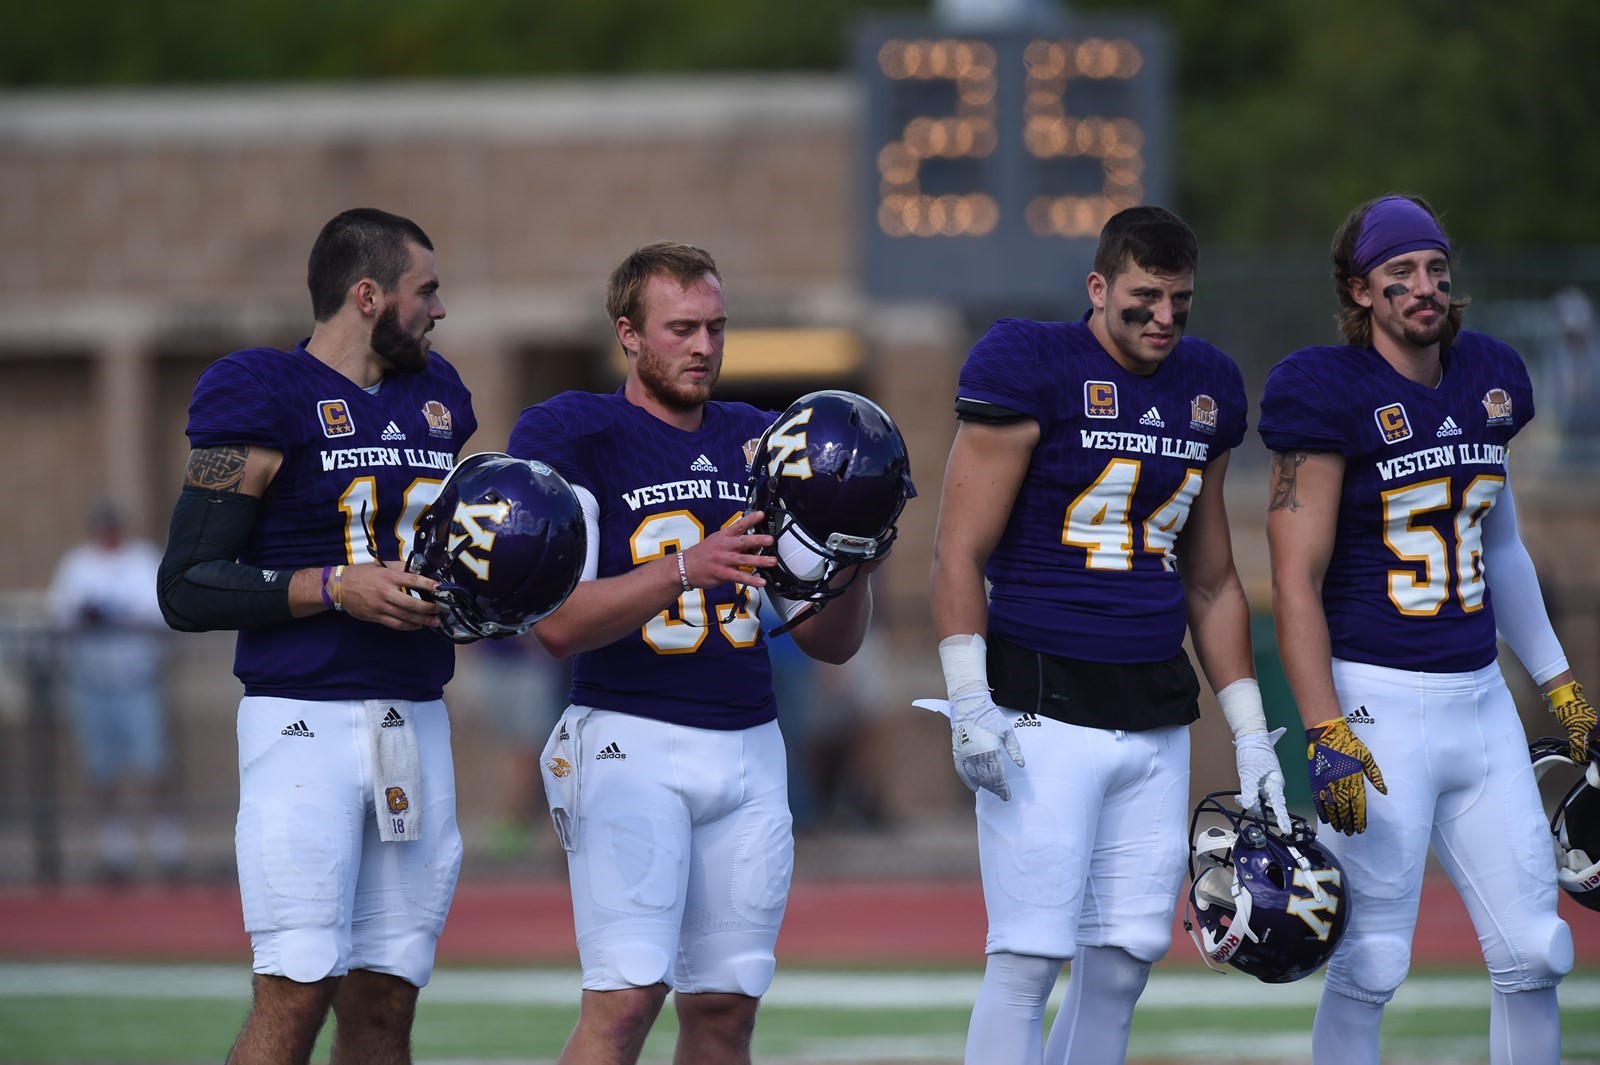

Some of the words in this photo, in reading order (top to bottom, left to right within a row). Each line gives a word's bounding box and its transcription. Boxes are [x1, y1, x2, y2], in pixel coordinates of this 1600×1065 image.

[877, 38, 1144, 238] 25
[1089, 384, 1113, 406] C
[322, 403, 347, 425] C
[1139, 417, 1165, 428] adidas
[1380, 407, 1404, 431] C
[381, 432, 406, 441] adidas
[1436, 427, 1463, 438] adidas
[1080, 429, 1158, 455] WESTERN
[1161, 437, 1209, 461] ILLINOIS
[320, 447, 402, 472] WESTERN
[404, 448, 454, 471] ILLINOI
[690, 464, 719, 473] adidas
[1376, 445, 1456, 481] WESTERN
[1458, 443, 1505, 465] ILLINO
[622, 479, 712, 511] WESTERN
[1061, 458, 1203, 573] 44
[1380, 474, 1506, 617] 58
[629, 509, 761, 655] 33
[381, 719, 405, 728] adidas
[1013, 720, 1042, 729] adidas
[1345, 716, 1375, 725] adidas
[281, 729, 315, 738] adidas
[595, 752, 627, 761] adidas
[392, 818, 405, 834] 18
[1212, 933, 1240, 961] Ridde
